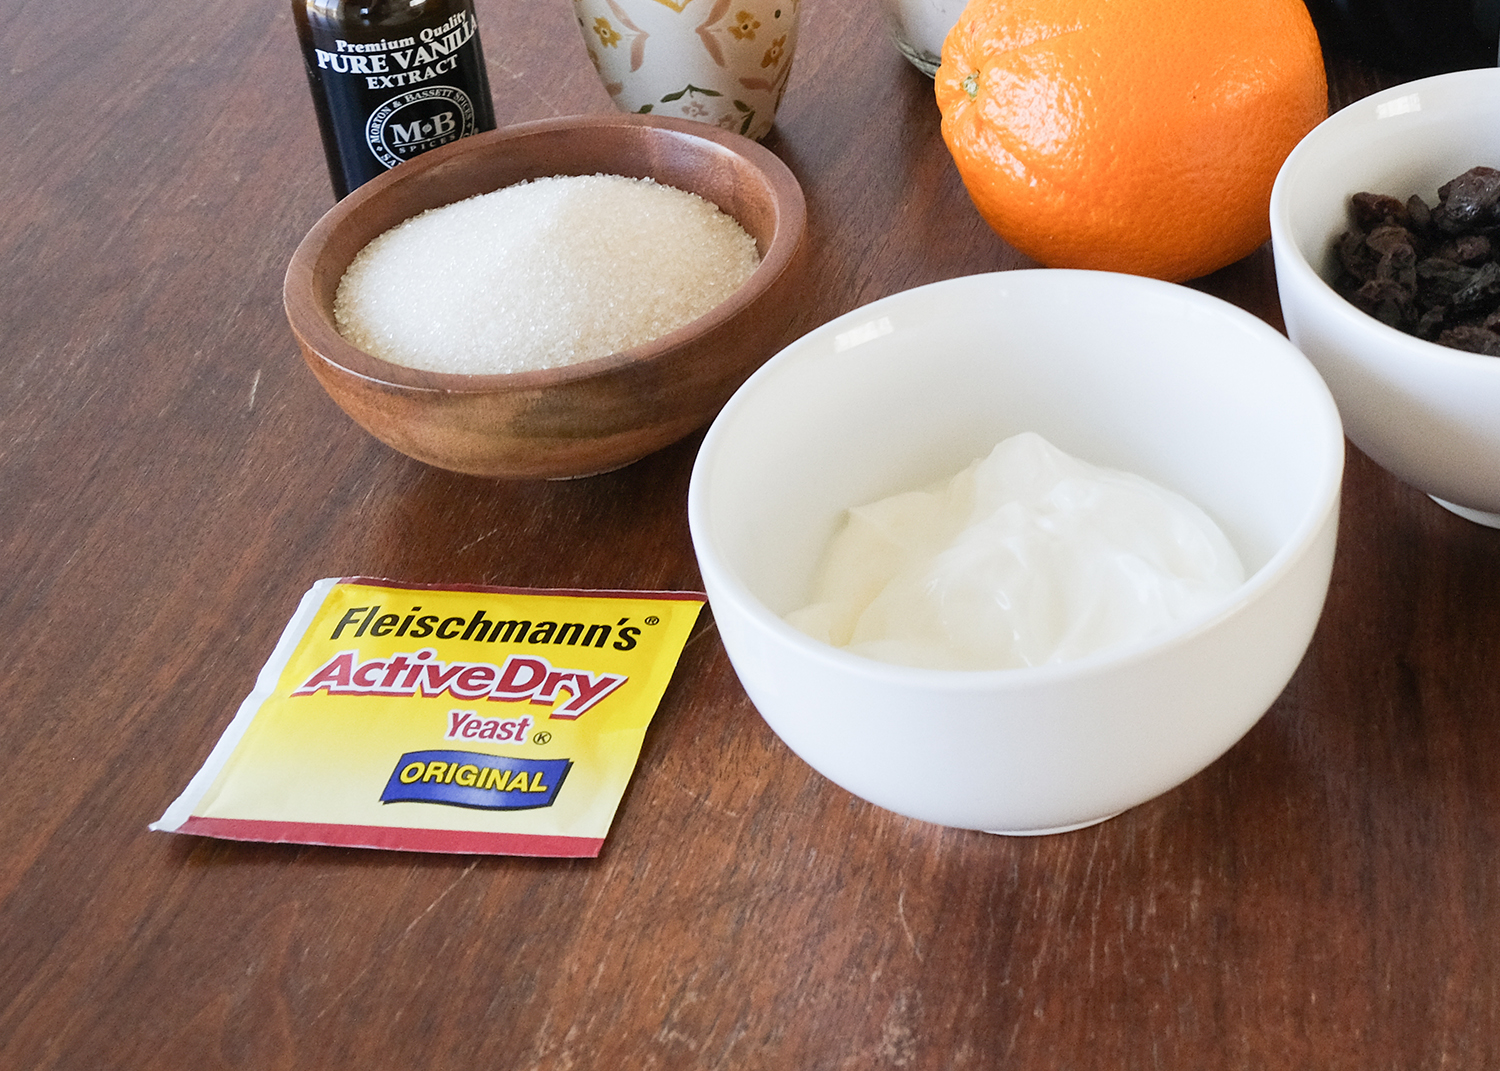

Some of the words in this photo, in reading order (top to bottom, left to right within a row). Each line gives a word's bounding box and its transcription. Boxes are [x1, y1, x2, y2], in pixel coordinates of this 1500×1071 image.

[315, 48, 389, 74] PURE
[391, 14, 478, 70] VANILLA
[335, 36, 416, 54] Premium
[420, 10, 467, 42] Quality
[366, 54, 458, 90] EXTRACT
[370, 106, 392, 144] MORTON
[392, 100, 402, 108] &
[404, 89, 454, 102] BASSETT
[453, 92, 472, 120] SPICES
[398, 134, 456, 154] SPICES
[330, 606, 642, 652] Fleischmann's
[448, 710, 531, 743] Yeast
[399, 760, 550, 794] ORIGINAL
